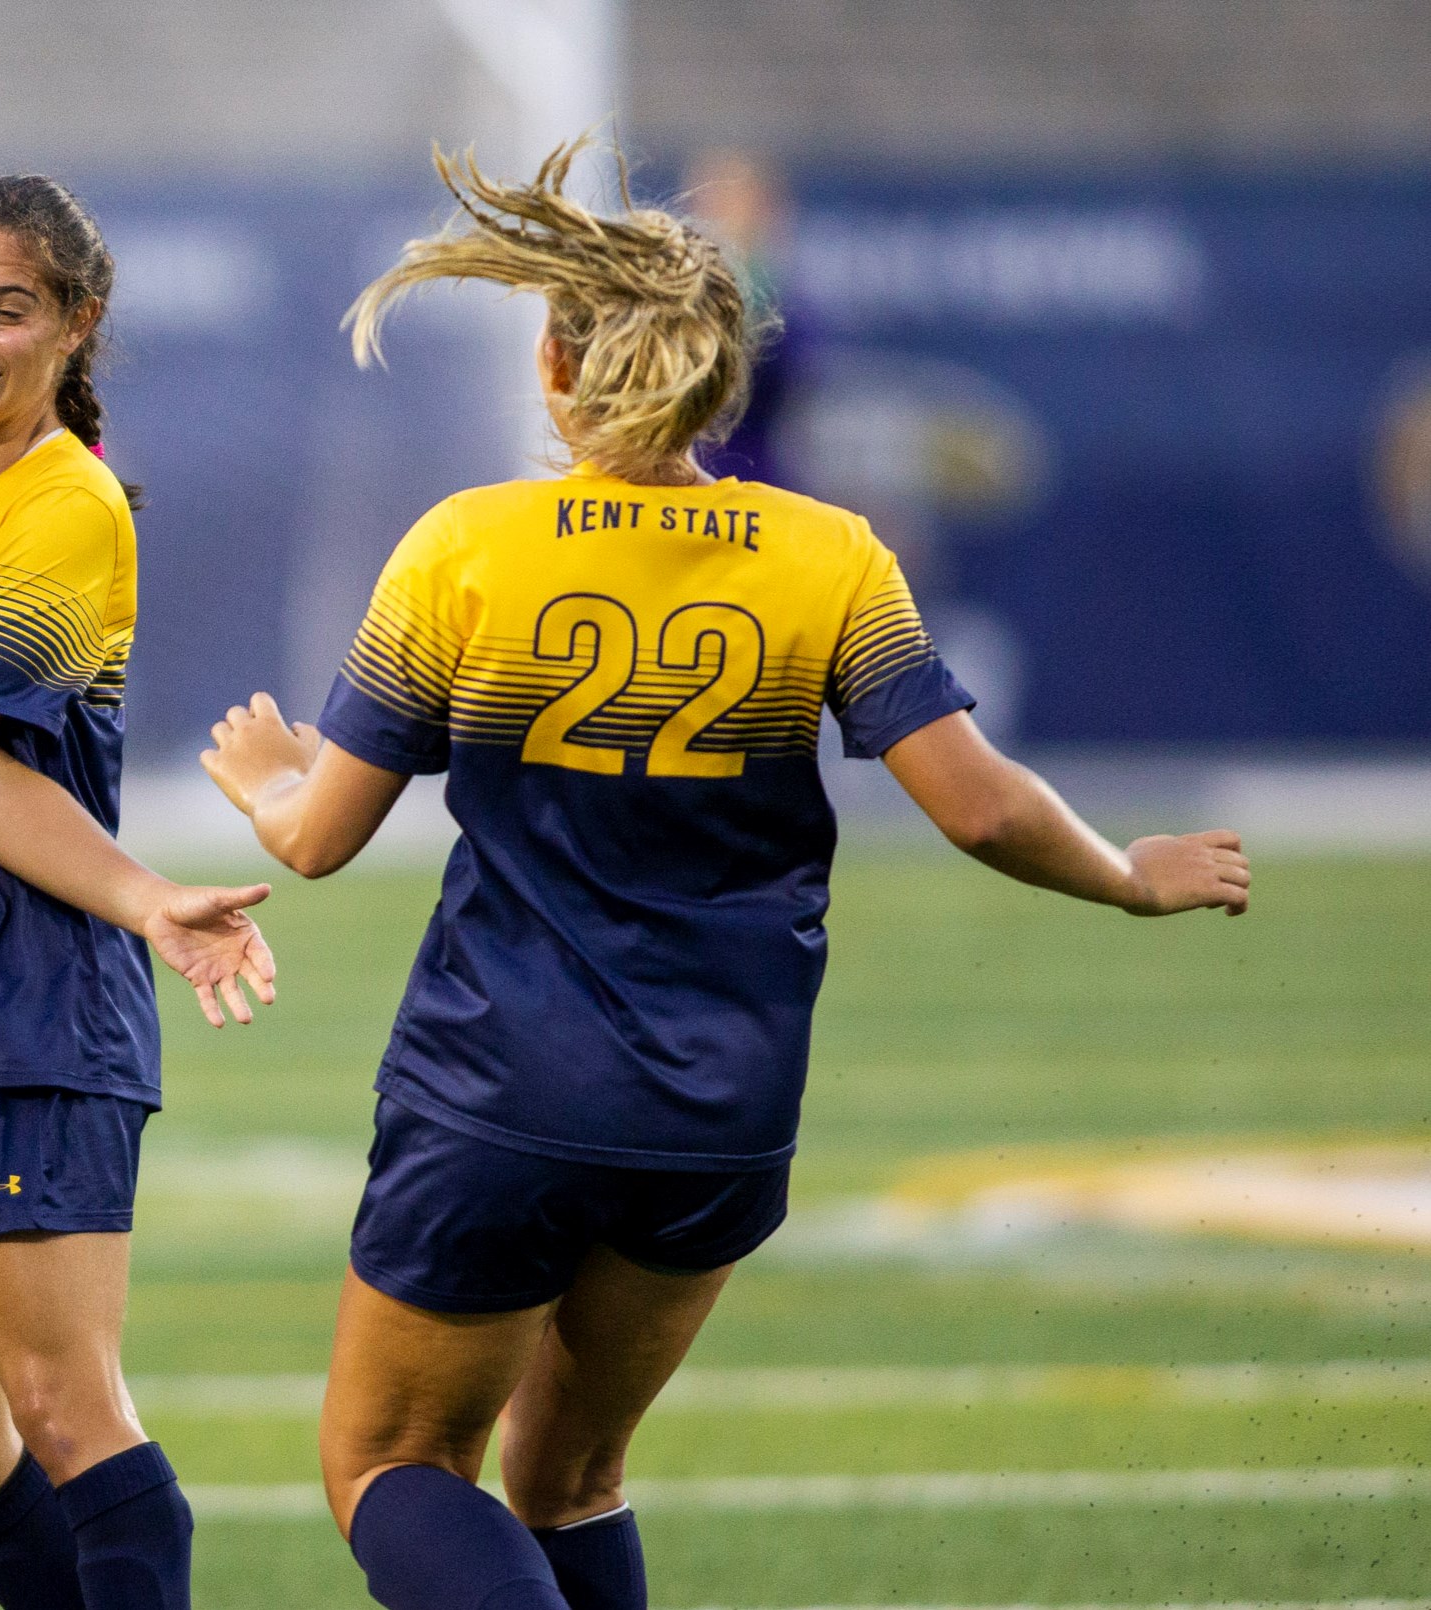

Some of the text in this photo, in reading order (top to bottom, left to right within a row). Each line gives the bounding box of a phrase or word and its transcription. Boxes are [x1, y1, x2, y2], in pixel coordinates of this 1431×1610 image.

[556, 498, 760, 552] KENT STATE
[520, 591, 765, 778] 22
